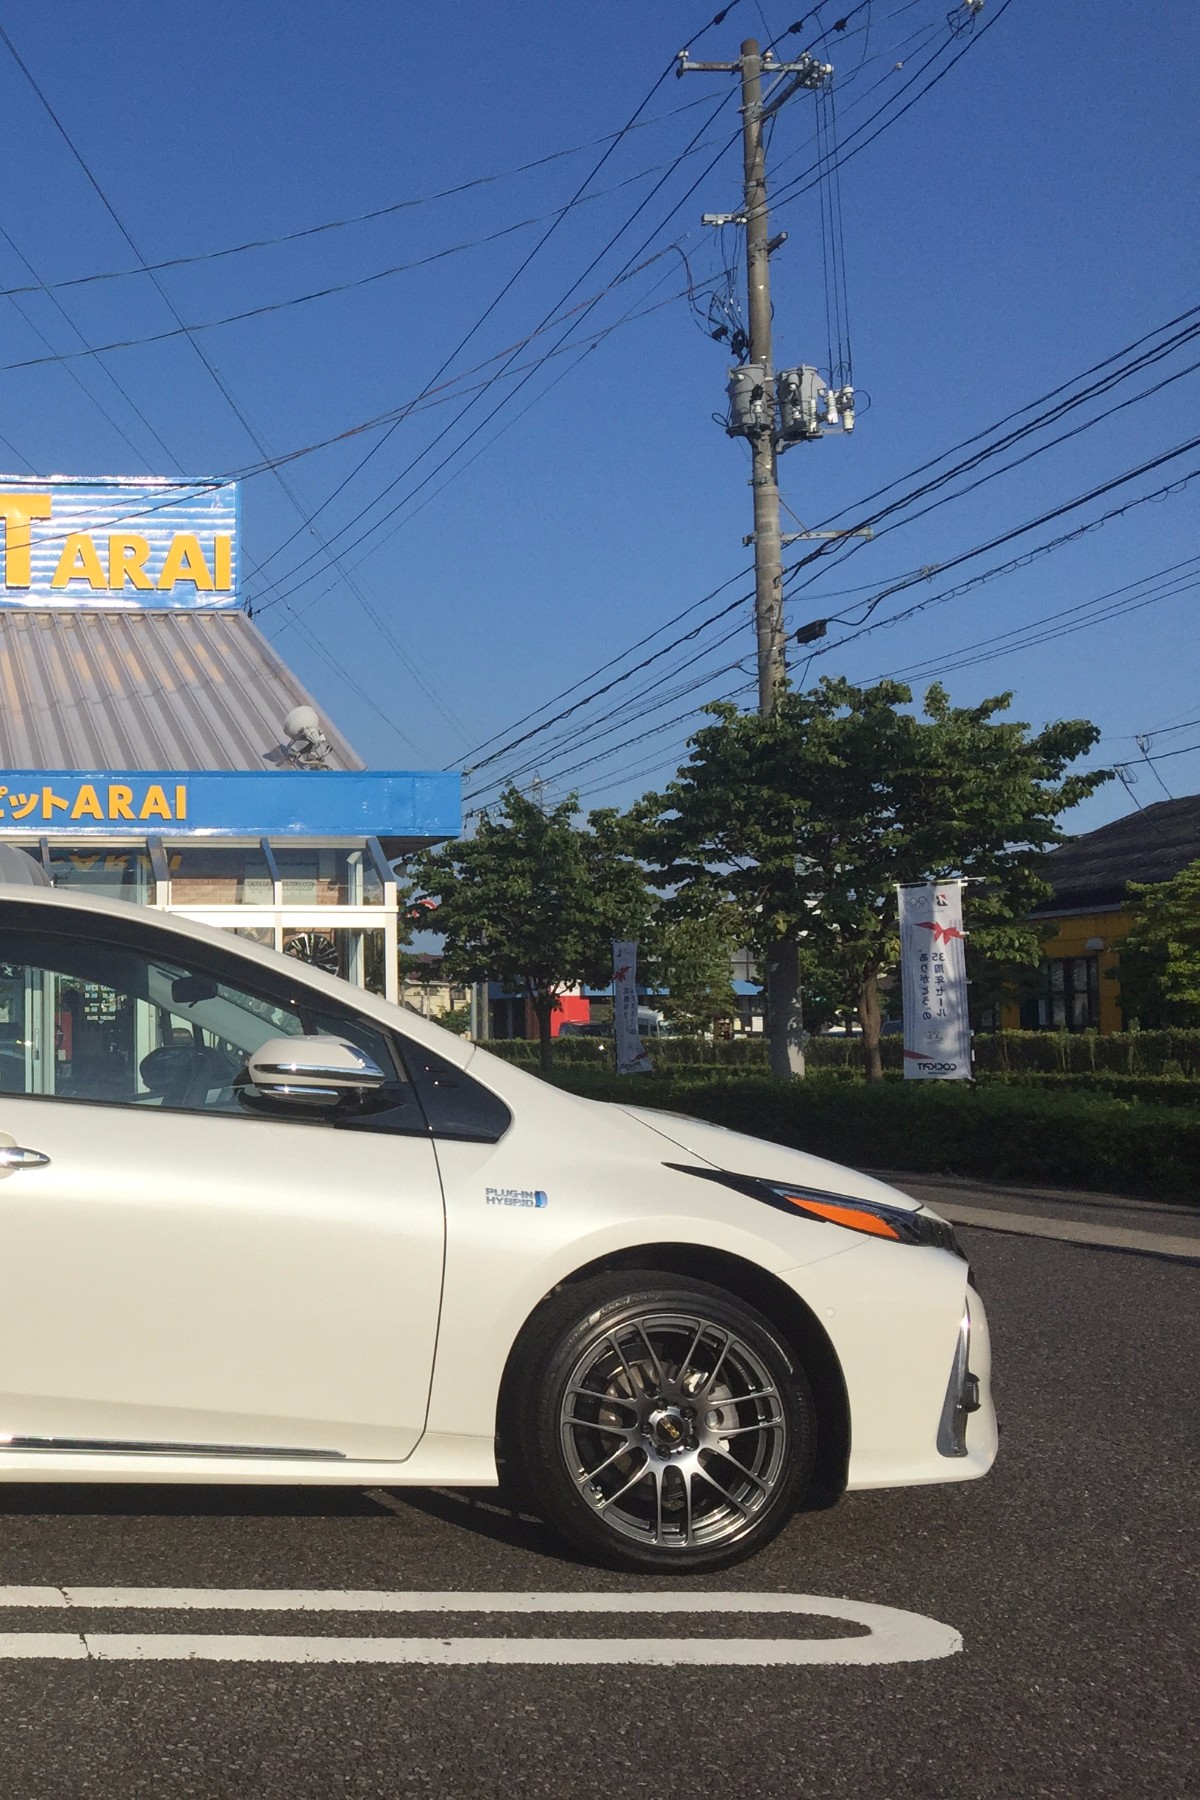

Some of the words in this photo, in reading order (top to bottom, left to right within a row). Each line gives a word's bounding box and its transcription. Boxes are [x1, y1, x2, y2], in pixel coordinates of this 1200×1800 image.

[52, 533, 232, 592] ARAI
[485, 1187, 534, 1199] PLUG-IN
[485, 1196, 534, 1208] HYBRID
